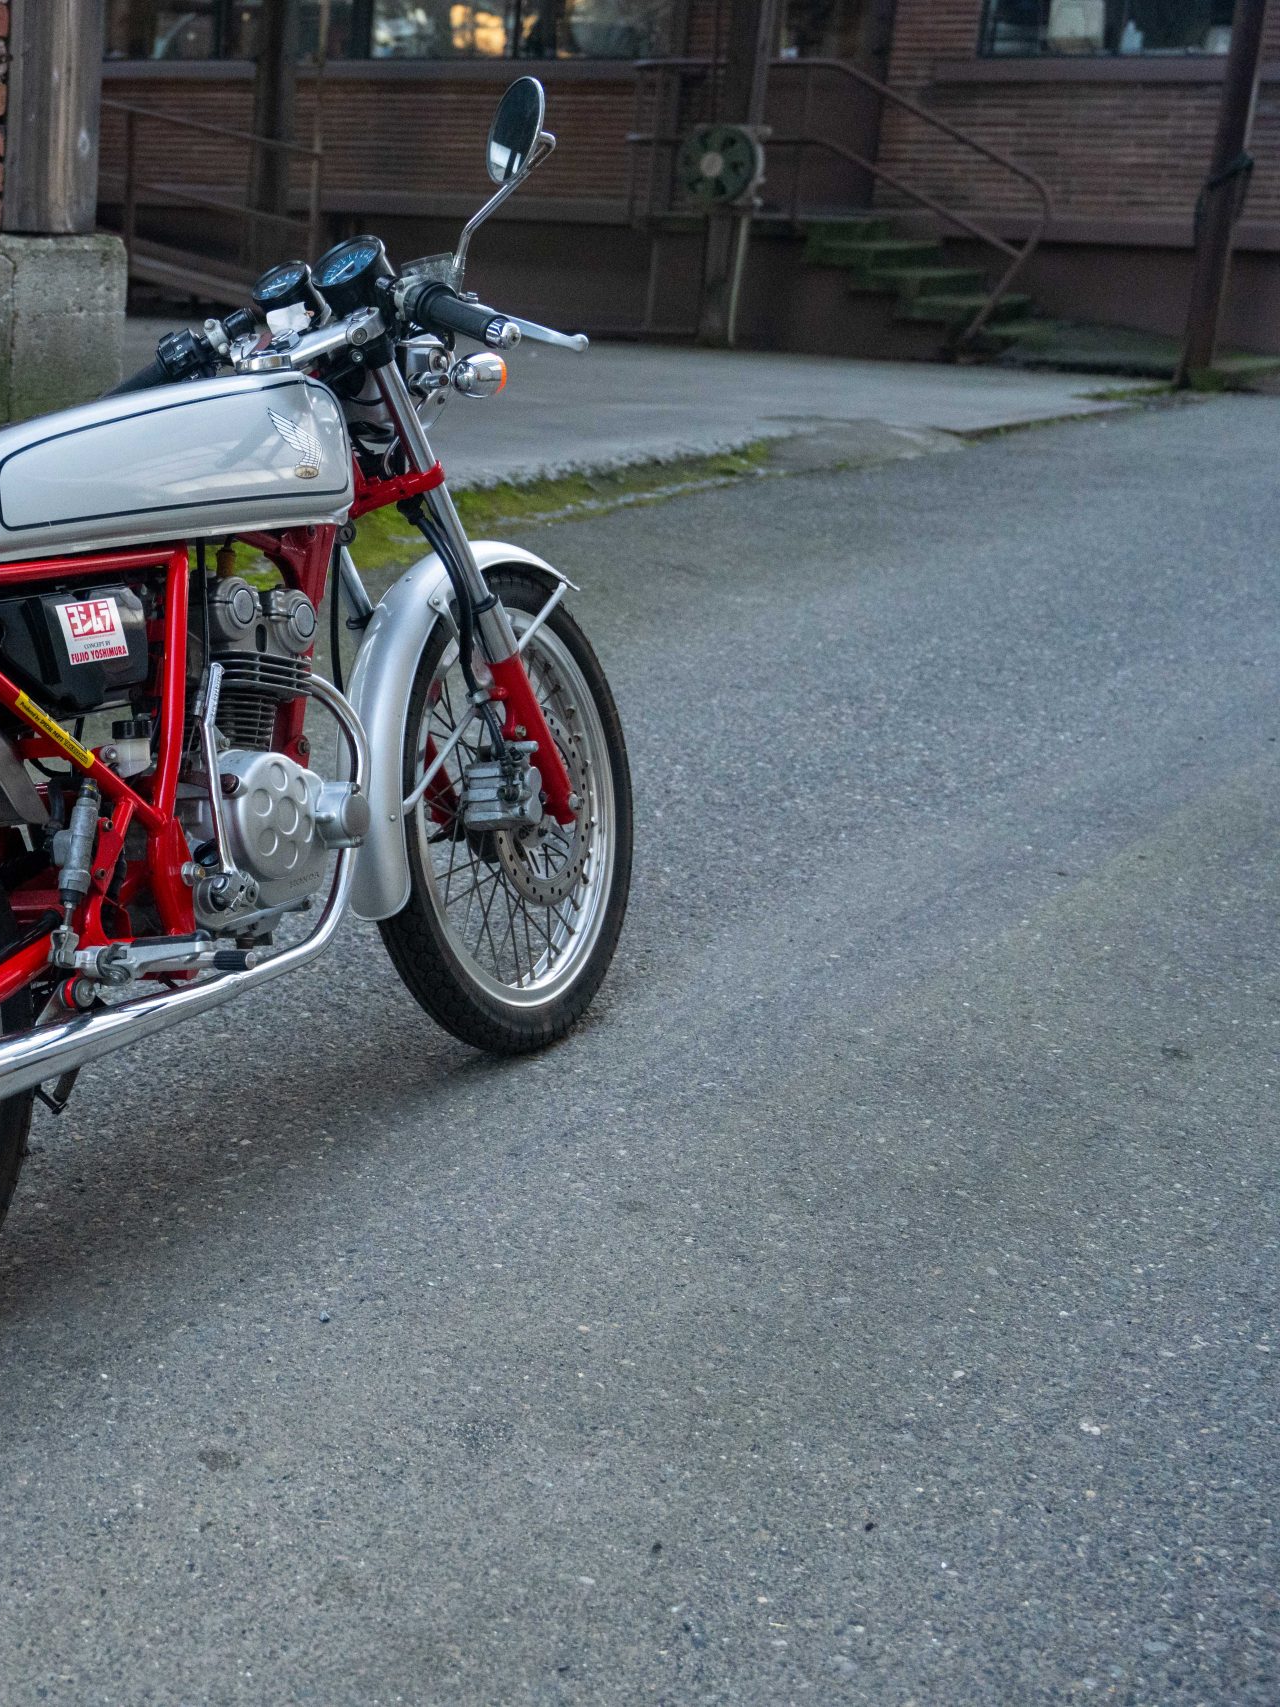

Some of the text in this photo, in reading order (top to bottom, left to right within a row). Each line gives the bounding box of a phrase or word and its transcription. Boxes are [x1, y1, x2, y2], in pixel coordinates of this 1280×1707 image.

[66, 602, 112, 636] ヨシムラ
[71, 645, 127, 664] FUJIO YOSHIMURA
[84, 641, 105, 649] CONCEPT
